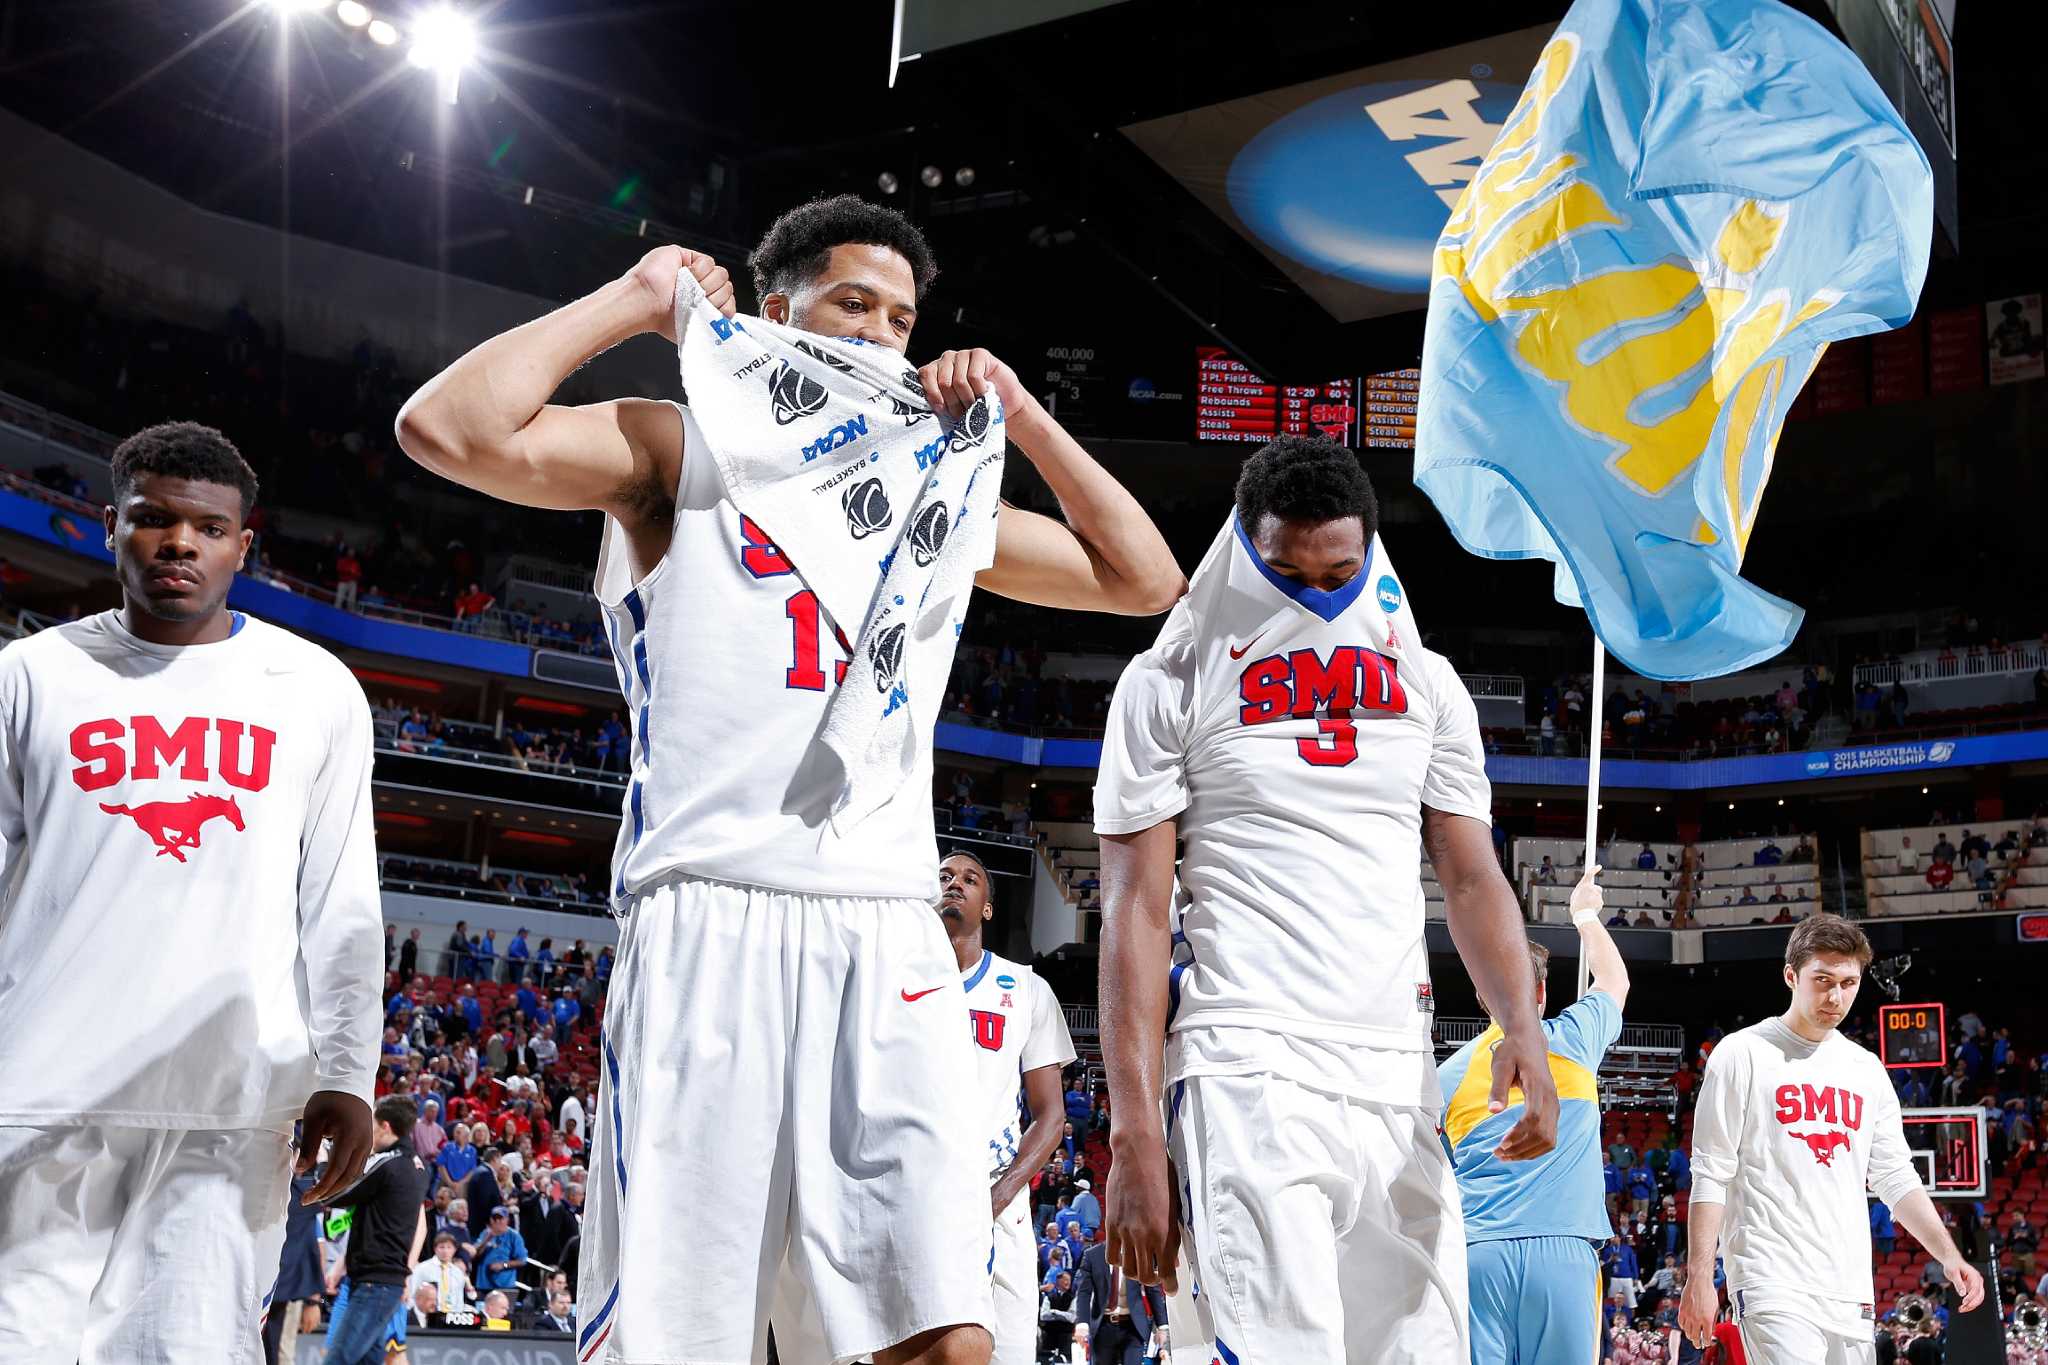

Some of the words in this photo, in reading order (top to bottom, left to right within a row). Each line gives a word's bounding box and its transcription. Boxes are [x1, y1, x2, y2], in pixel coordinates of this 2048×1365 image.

[1046, 347, 1094, 361] 400,000
[1201, 360, 1228, 370] Field
[1224, 373, 1247, 383] Field
[1201, 384, 1224, 394] Free
[1228, 386, 1264, 395] Throws
[1392, 380, 1414, 390] Field
[1070, 387, 1080, 400] 3
[1369, 391, 1392, 401] Free
[1396, 392, 1418, 402] Thro
[1200, 396, 1251, 407] Rebounds
[1200, 408, 1236, 418] Assists
[1289, 412, 1300, 420] 12
[1311, 404, 1356, 424] SMU
[1199, 420, 1231, 430] Steals
[1369, 415, 1404, 425] Assists
[1289, 423, 1300, 432] 11
[1369, 427, 1399, 437] Steals
[801, 414, 869, 462] NCAA
[1199, 431, 1240, 441] Blocked
[1243, 433, 1271, 443] Shots
[1368, 438, 1409, 449] Blocked
[811, 459, 867, 497] BASKETBALL
[1240, 645, 1408, 727] SMU
[1296, 718, 1359, 768] 3
[69, 715, 277, 793] SMU
[1834, 752, 1857, 762] 2015
[1859, 746, 1925, 760] BASKETBALL
[1834, 754, 1926, 771] CHAMPIONSHIP
[1775, 1083, 1865, 1132] SMU
